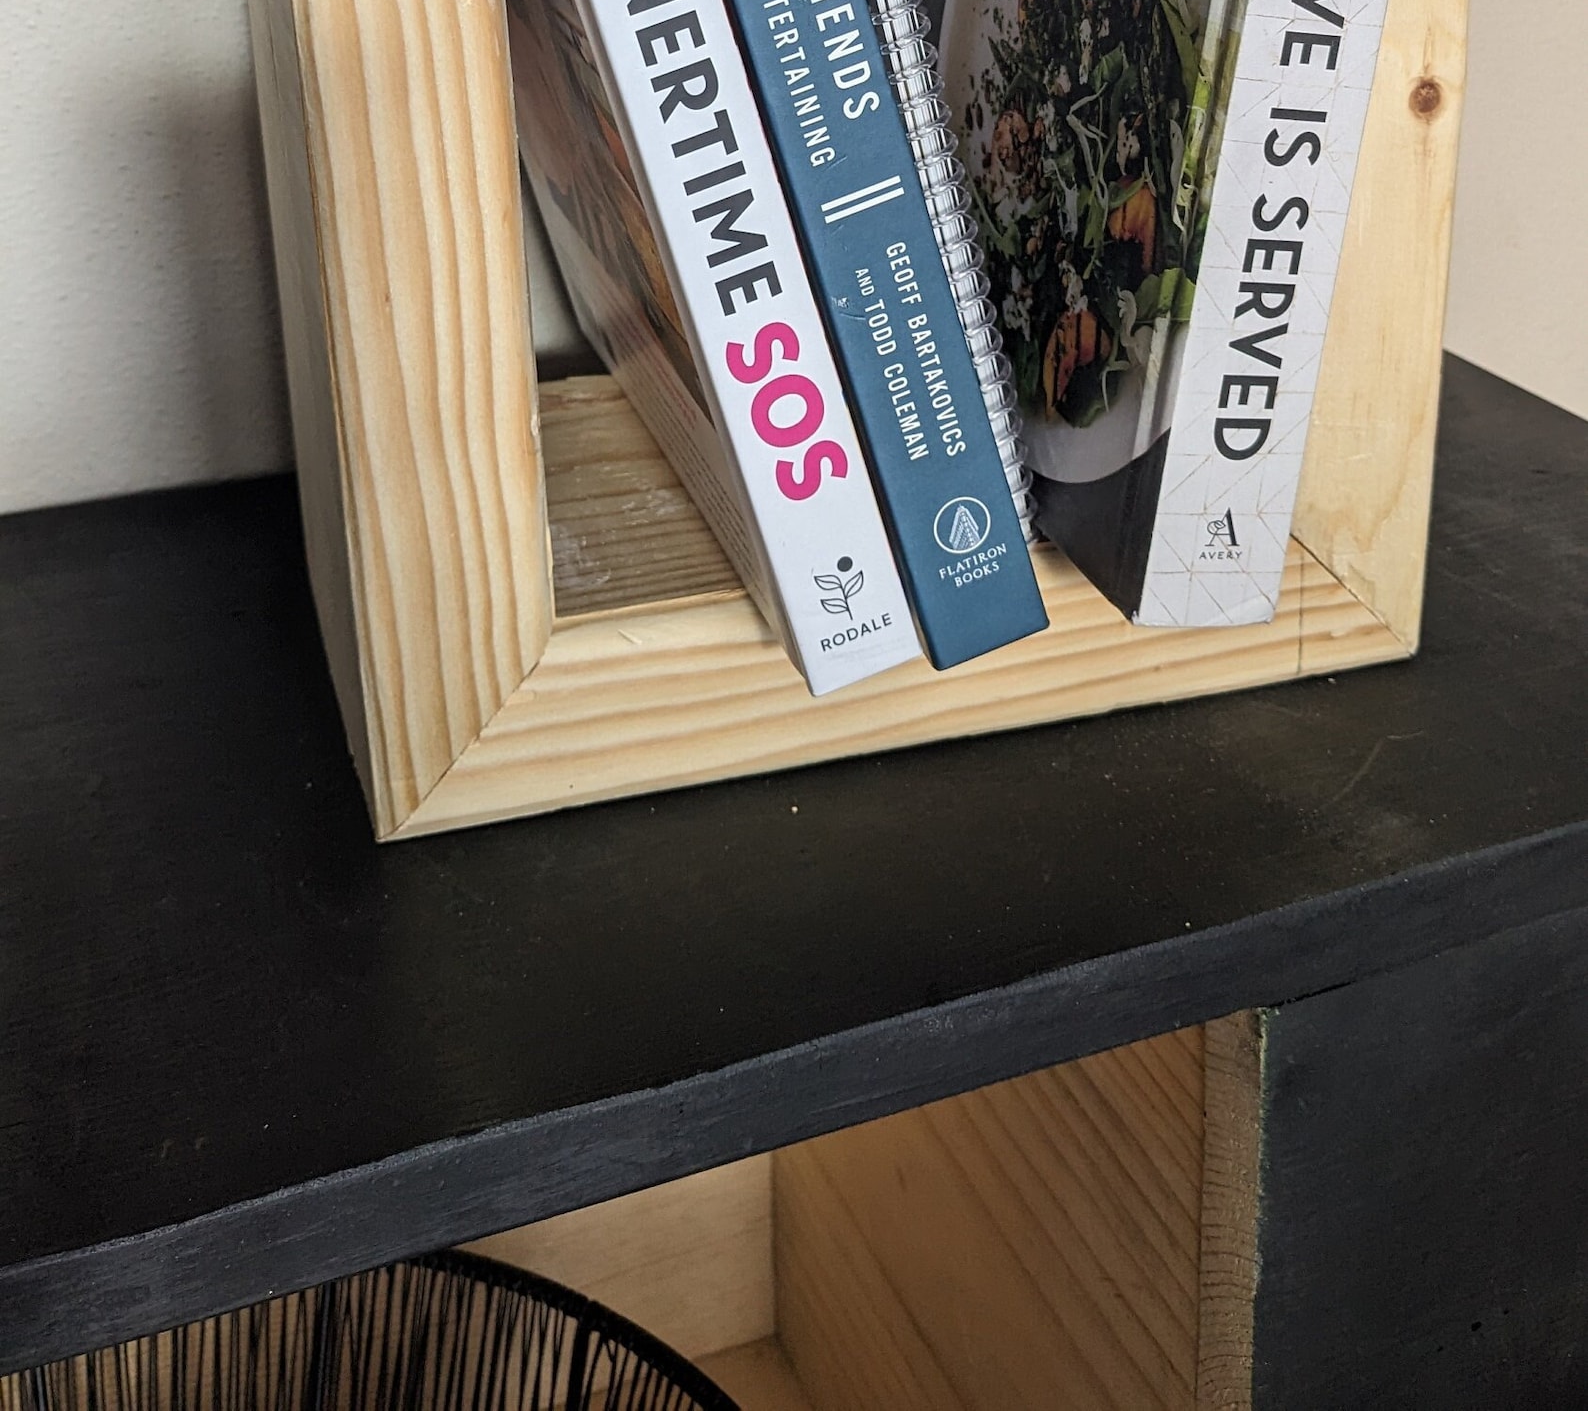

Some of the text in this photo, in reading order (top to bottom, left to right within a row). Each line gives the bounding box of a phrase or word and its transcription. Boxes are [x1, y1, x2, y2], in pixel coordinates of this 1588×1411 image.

[1263, 106, 1328, 167] IS
[886, 241, 966, 457] GEOFF BARTAKOVICS
[1213, 193, 1309, 461] SERVED
[855, 268, 929, 461] AND TODD COLEMAN
[726, 322, 848, 501] SOS
[939, 543, 1007, 580] FLATIRON
[954, 561, 1000, 588] BOOKS
[1199, 550, 1243, 560] AVERY
[821, 613, 892, 652] RODALE
